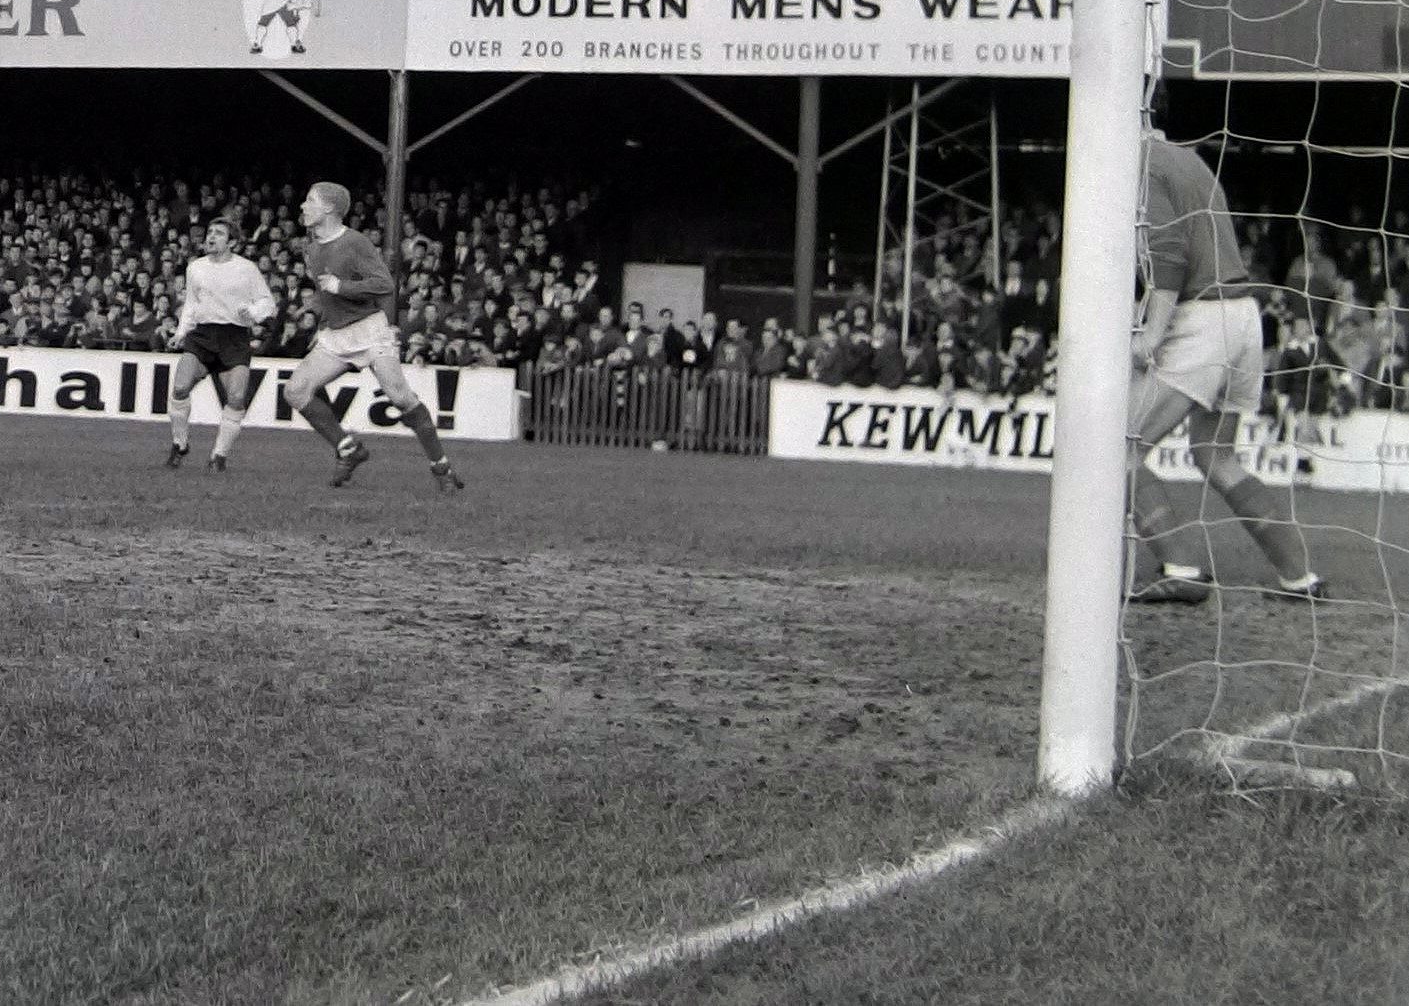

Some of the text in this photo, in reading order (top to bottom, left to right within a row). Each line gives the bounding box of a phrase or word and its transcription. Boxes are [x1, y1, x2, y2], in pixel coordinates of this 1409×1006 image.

[449, 39, 1073, 63] OVER 200 BRANCHES THROUGHOUT THE COUNT
